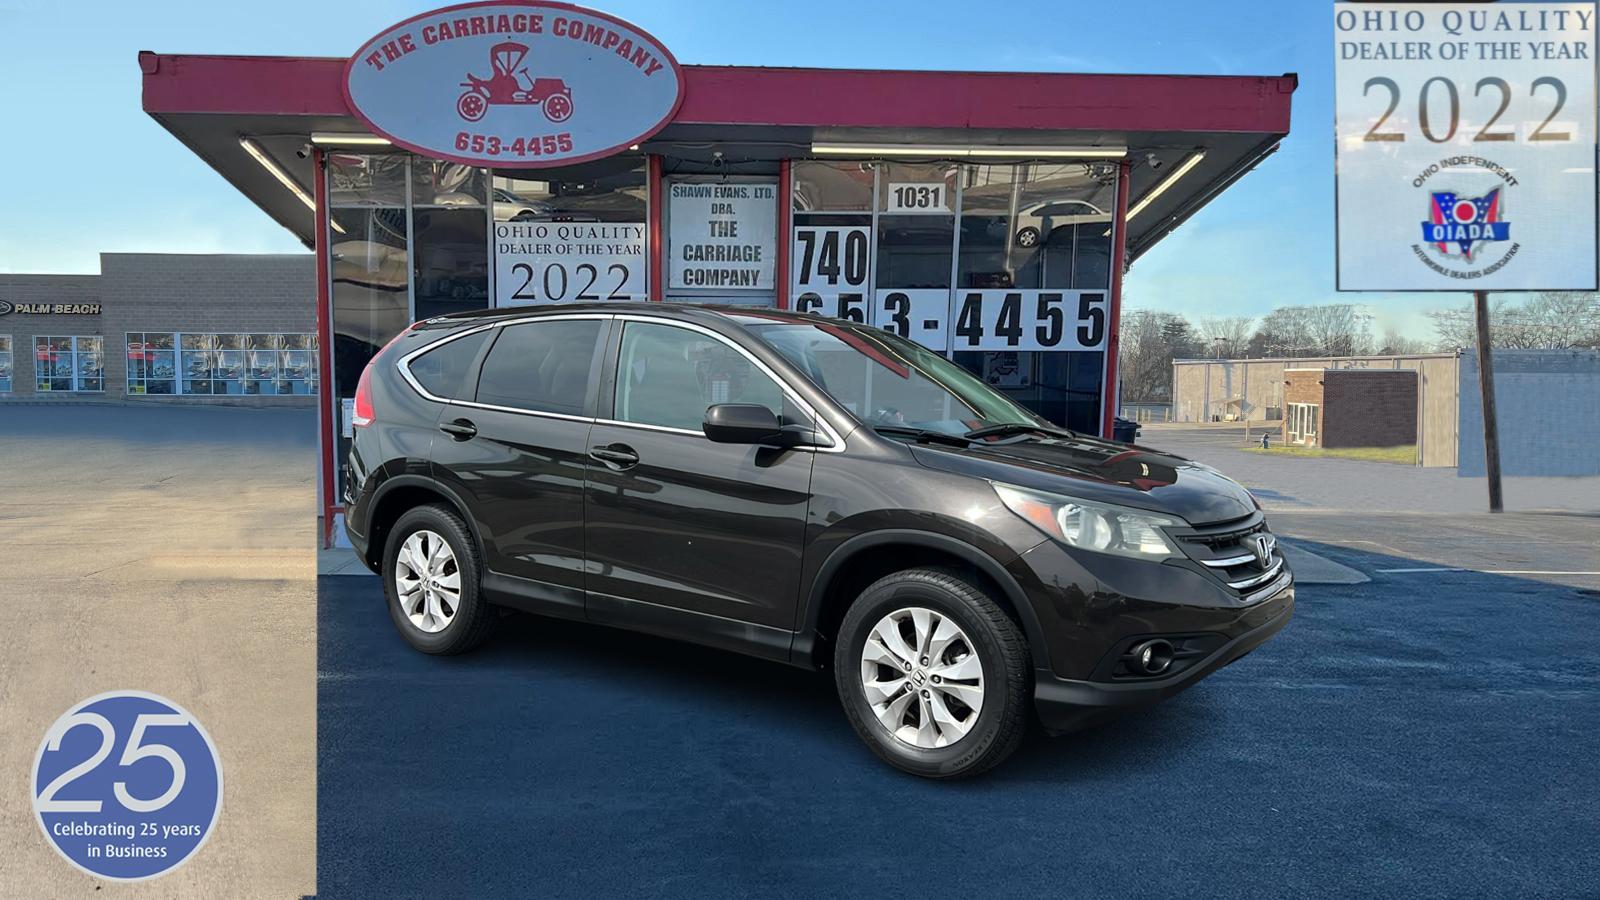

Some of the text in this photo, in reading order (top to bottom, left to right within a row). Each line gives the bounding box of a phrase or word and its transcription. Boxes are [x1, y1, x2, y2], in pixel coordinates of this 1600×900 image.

[1336, 10, 1592, 35] OHIO QUALITY
[366, 14, 663, 77] THE CARRIAGE COMPANY
[1340, 41, 1589, 60] DEALER OF THE YEAR
[1363, 76, 1571, 143] 2022
[455, 132, 573, 157] 653-4455
[1412, 156, 1519, 188] OHIO INDEPENDENT
[672, 186, 711, 198] SHAWN
[894, 187, 940, 208] 1031
[711, 203, 736, 215] DBA.
[497, 225, 644, 241] OHIO QUALITY
[708, 221, 738, 238] THE
[1432, 224, 1495, 240] OIADA
[499, 243, 642, 255] DEALER OF THE YEAR
[683, 244, 762, 262] CARRIAGE
[797, 230, 868, 286] 740
[1449, 270, 1482, 280] DEALERS
[1482, 242, 1520, 276] ASSOCIATION
[511, 263, 632, 301] 2022
[683, 269, 760, 286] COMPANY
[14, 304, 50, 314] PALM
